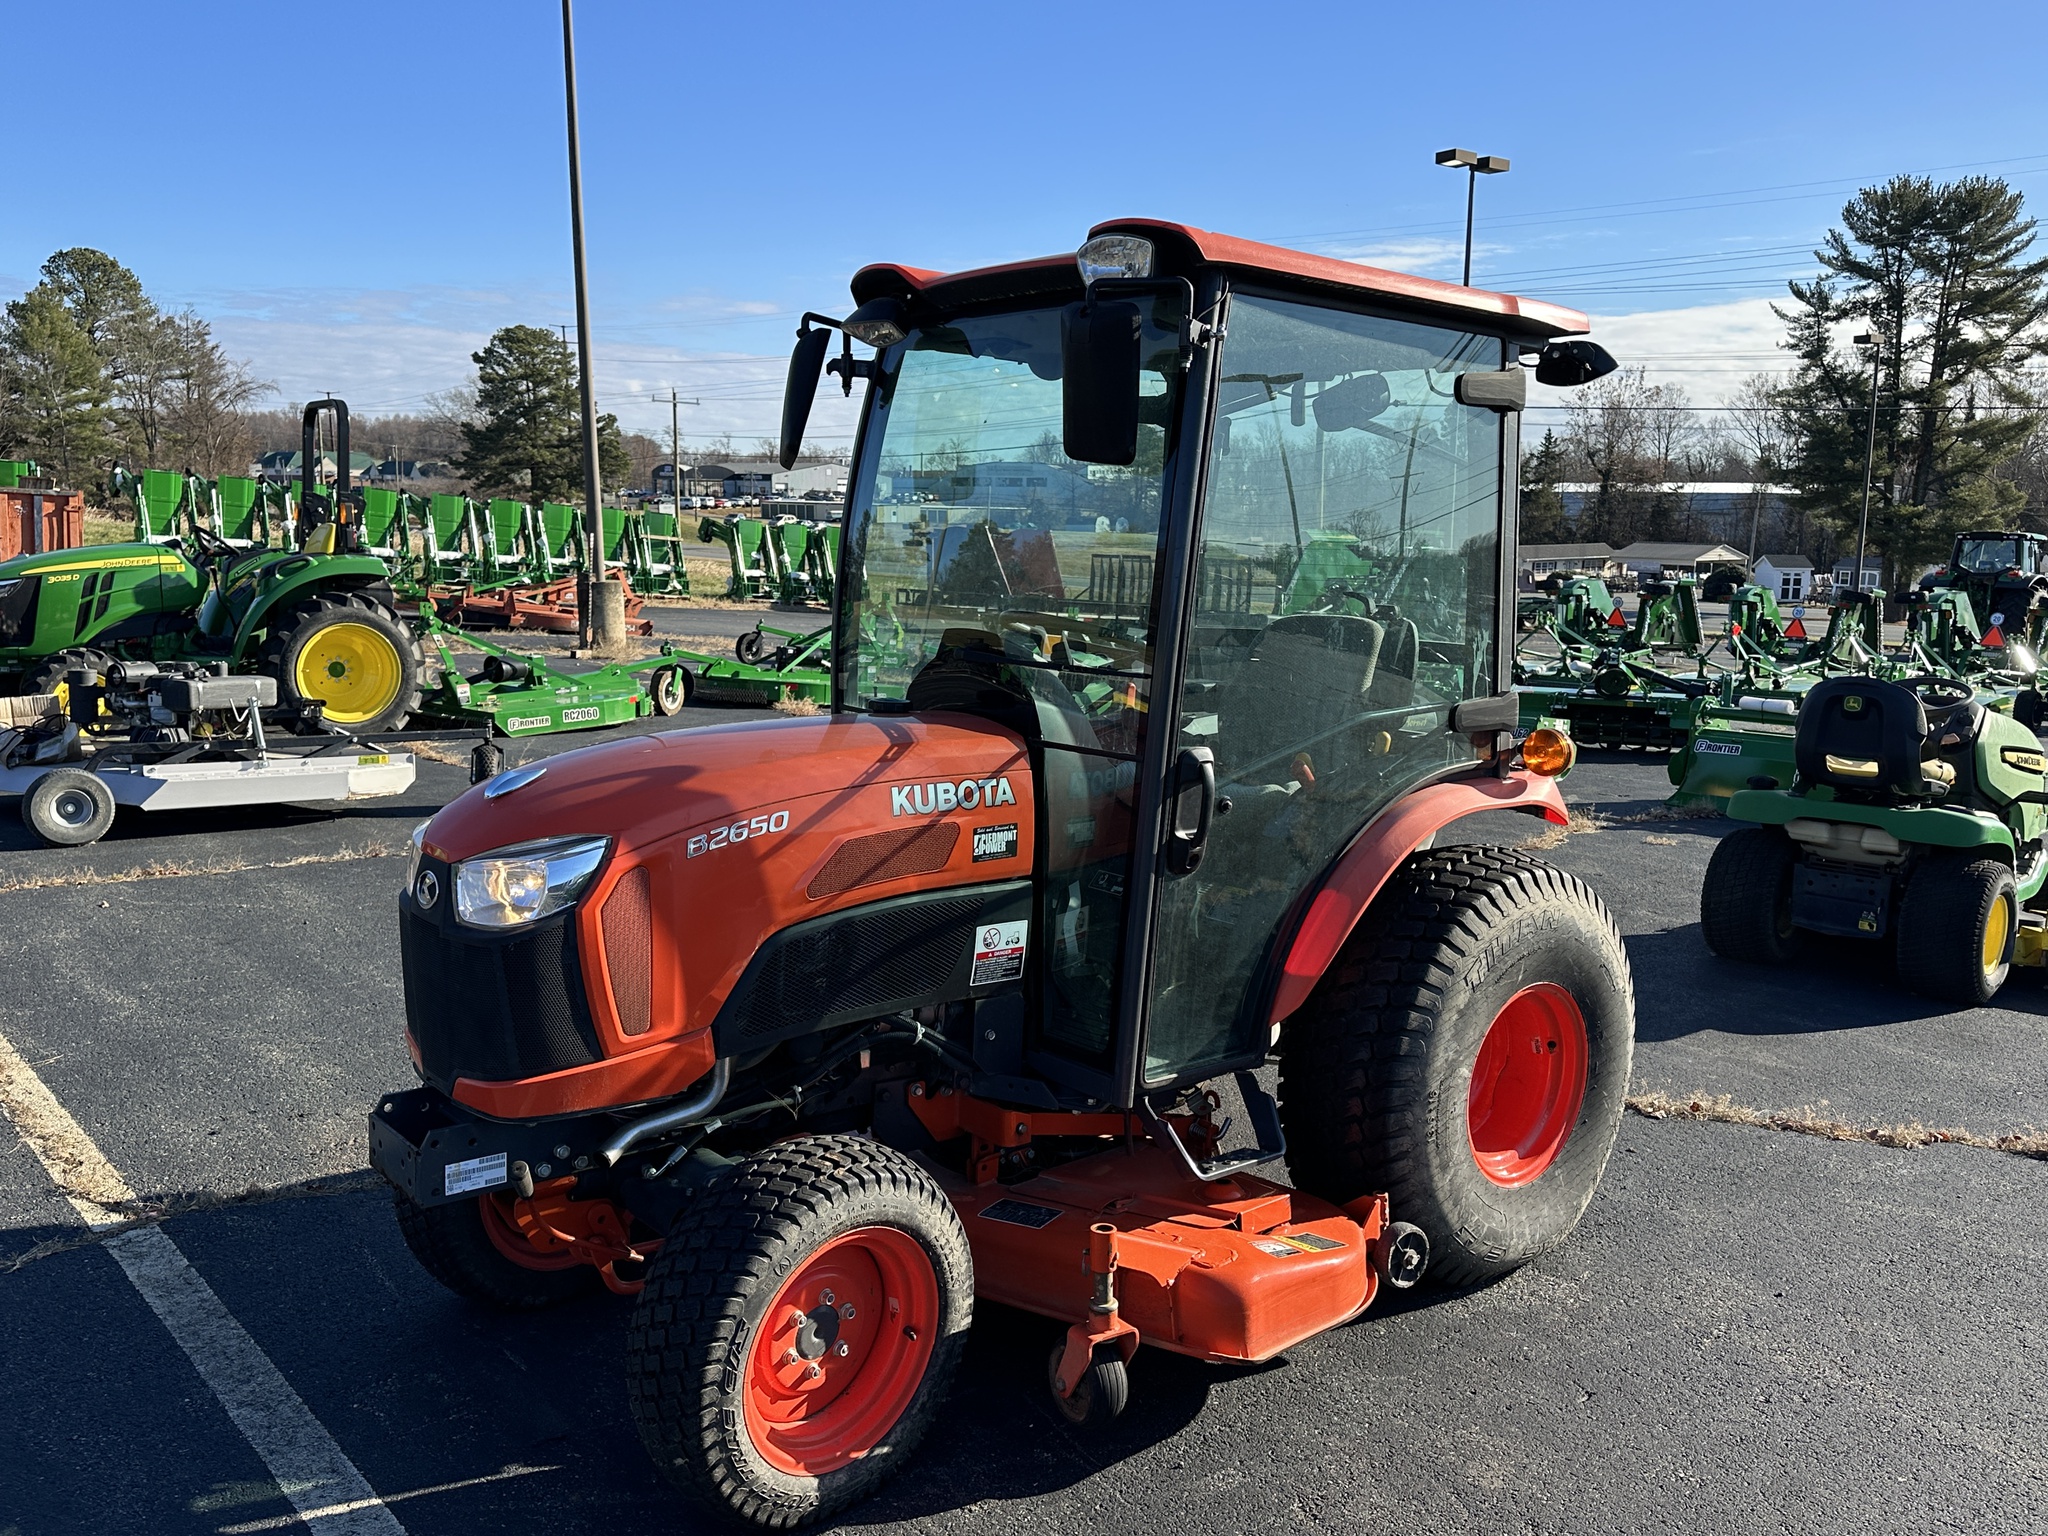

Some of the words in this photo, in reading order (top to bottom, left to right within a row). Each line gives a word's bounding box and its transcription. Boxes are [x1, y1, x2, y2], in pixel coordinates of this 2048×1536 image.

[47, 575, 71, 584] 3035
[563, 708, 599, 721] RC2060
[509, 716, 550, 730] FRONTIER
[1695, 739, 1741, 754] FRONTIER
[889, 776, 1016, 819] KUBOTA
[686, 810, 790, 859] B2650
[981, 829, 1017, 843] PIEDMONT
[980, 841, 1006, 855] POWER
